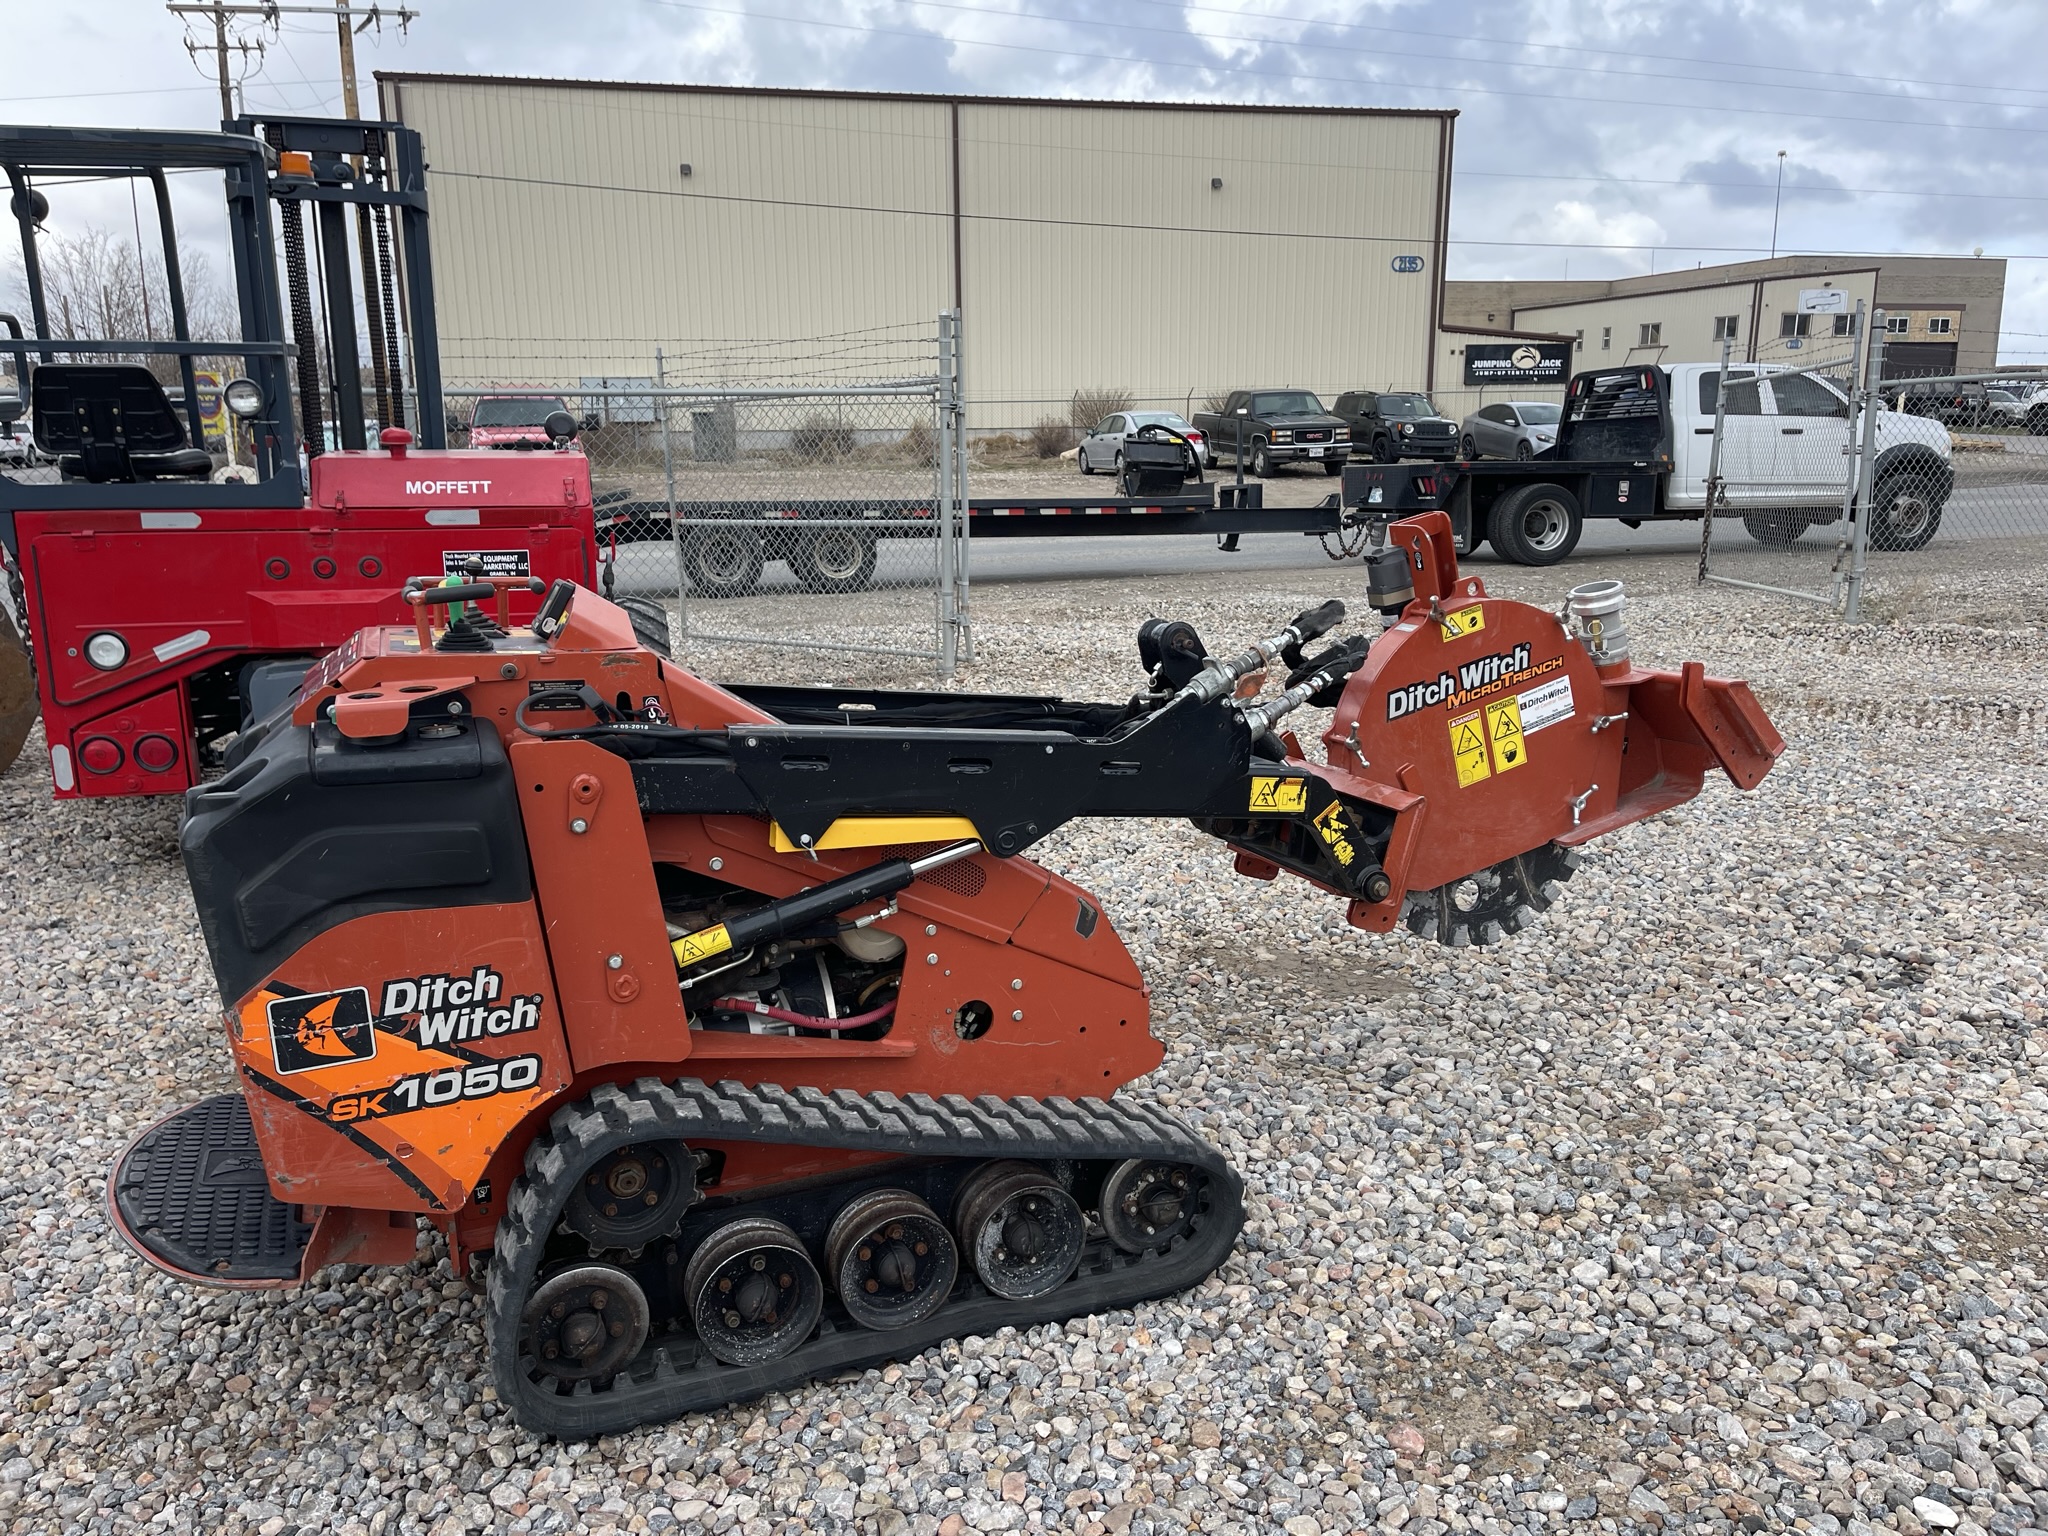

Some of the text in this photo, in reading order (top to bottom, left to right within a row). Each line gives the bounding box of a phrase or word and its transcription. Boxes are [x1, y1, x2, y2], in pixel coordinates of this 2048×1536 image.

[1472, 359, 1562, 368] JUMPING JACK
[406, 481, 491, 494] MOFFETT
[1389, 647, 1529, 719] Ditch Witch
[1493, 698, 1515, 710] CAUTION
[1528, 685, 1569, 708] Ditch Witch
[1455, 712, 1479, 725] DANGER
[384, 969, 499, 1017] Ditch
[420, 998, 538, 1046] Witch
[332, 1057, 538, 1122] SK 1050
